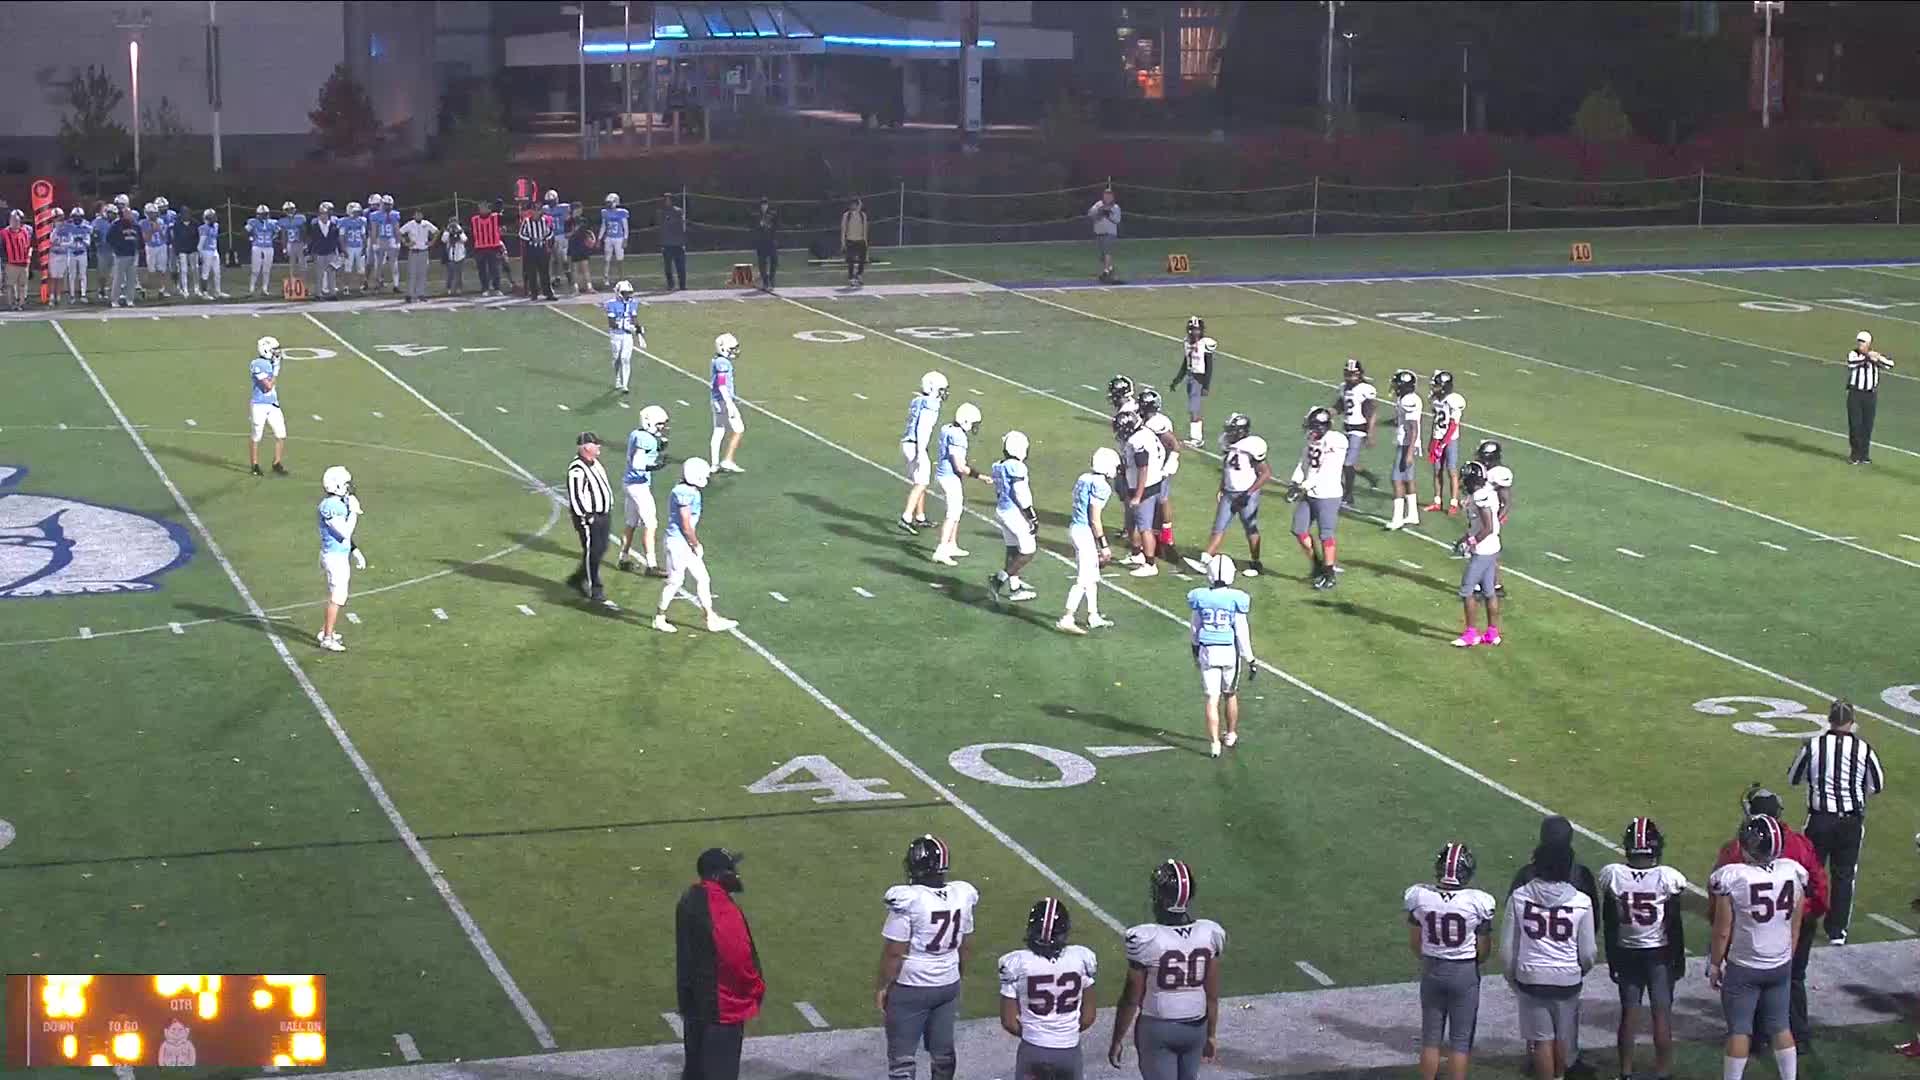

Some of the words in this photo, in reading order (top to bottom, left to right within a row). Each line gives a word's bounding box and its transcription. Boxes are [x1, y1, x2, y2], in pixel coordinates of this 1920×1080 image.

[1172, 255, 1188, 271] 20
[1576, 244, 1591, 260] 10
[285, 279, 302, 297] 40
[744, 742, 1097, 804] 40
[1523, 901, 1574, 942] 56
[1618, 891, 1658, 927] 15
[1749, 880, 1795, 924] 54
[925, 909, 961, 952] 71
[1424, 911, 1467, 948] 10
[1157, 947, 1213, 990] 60
[1027, 971, 1082, 1017] 52
